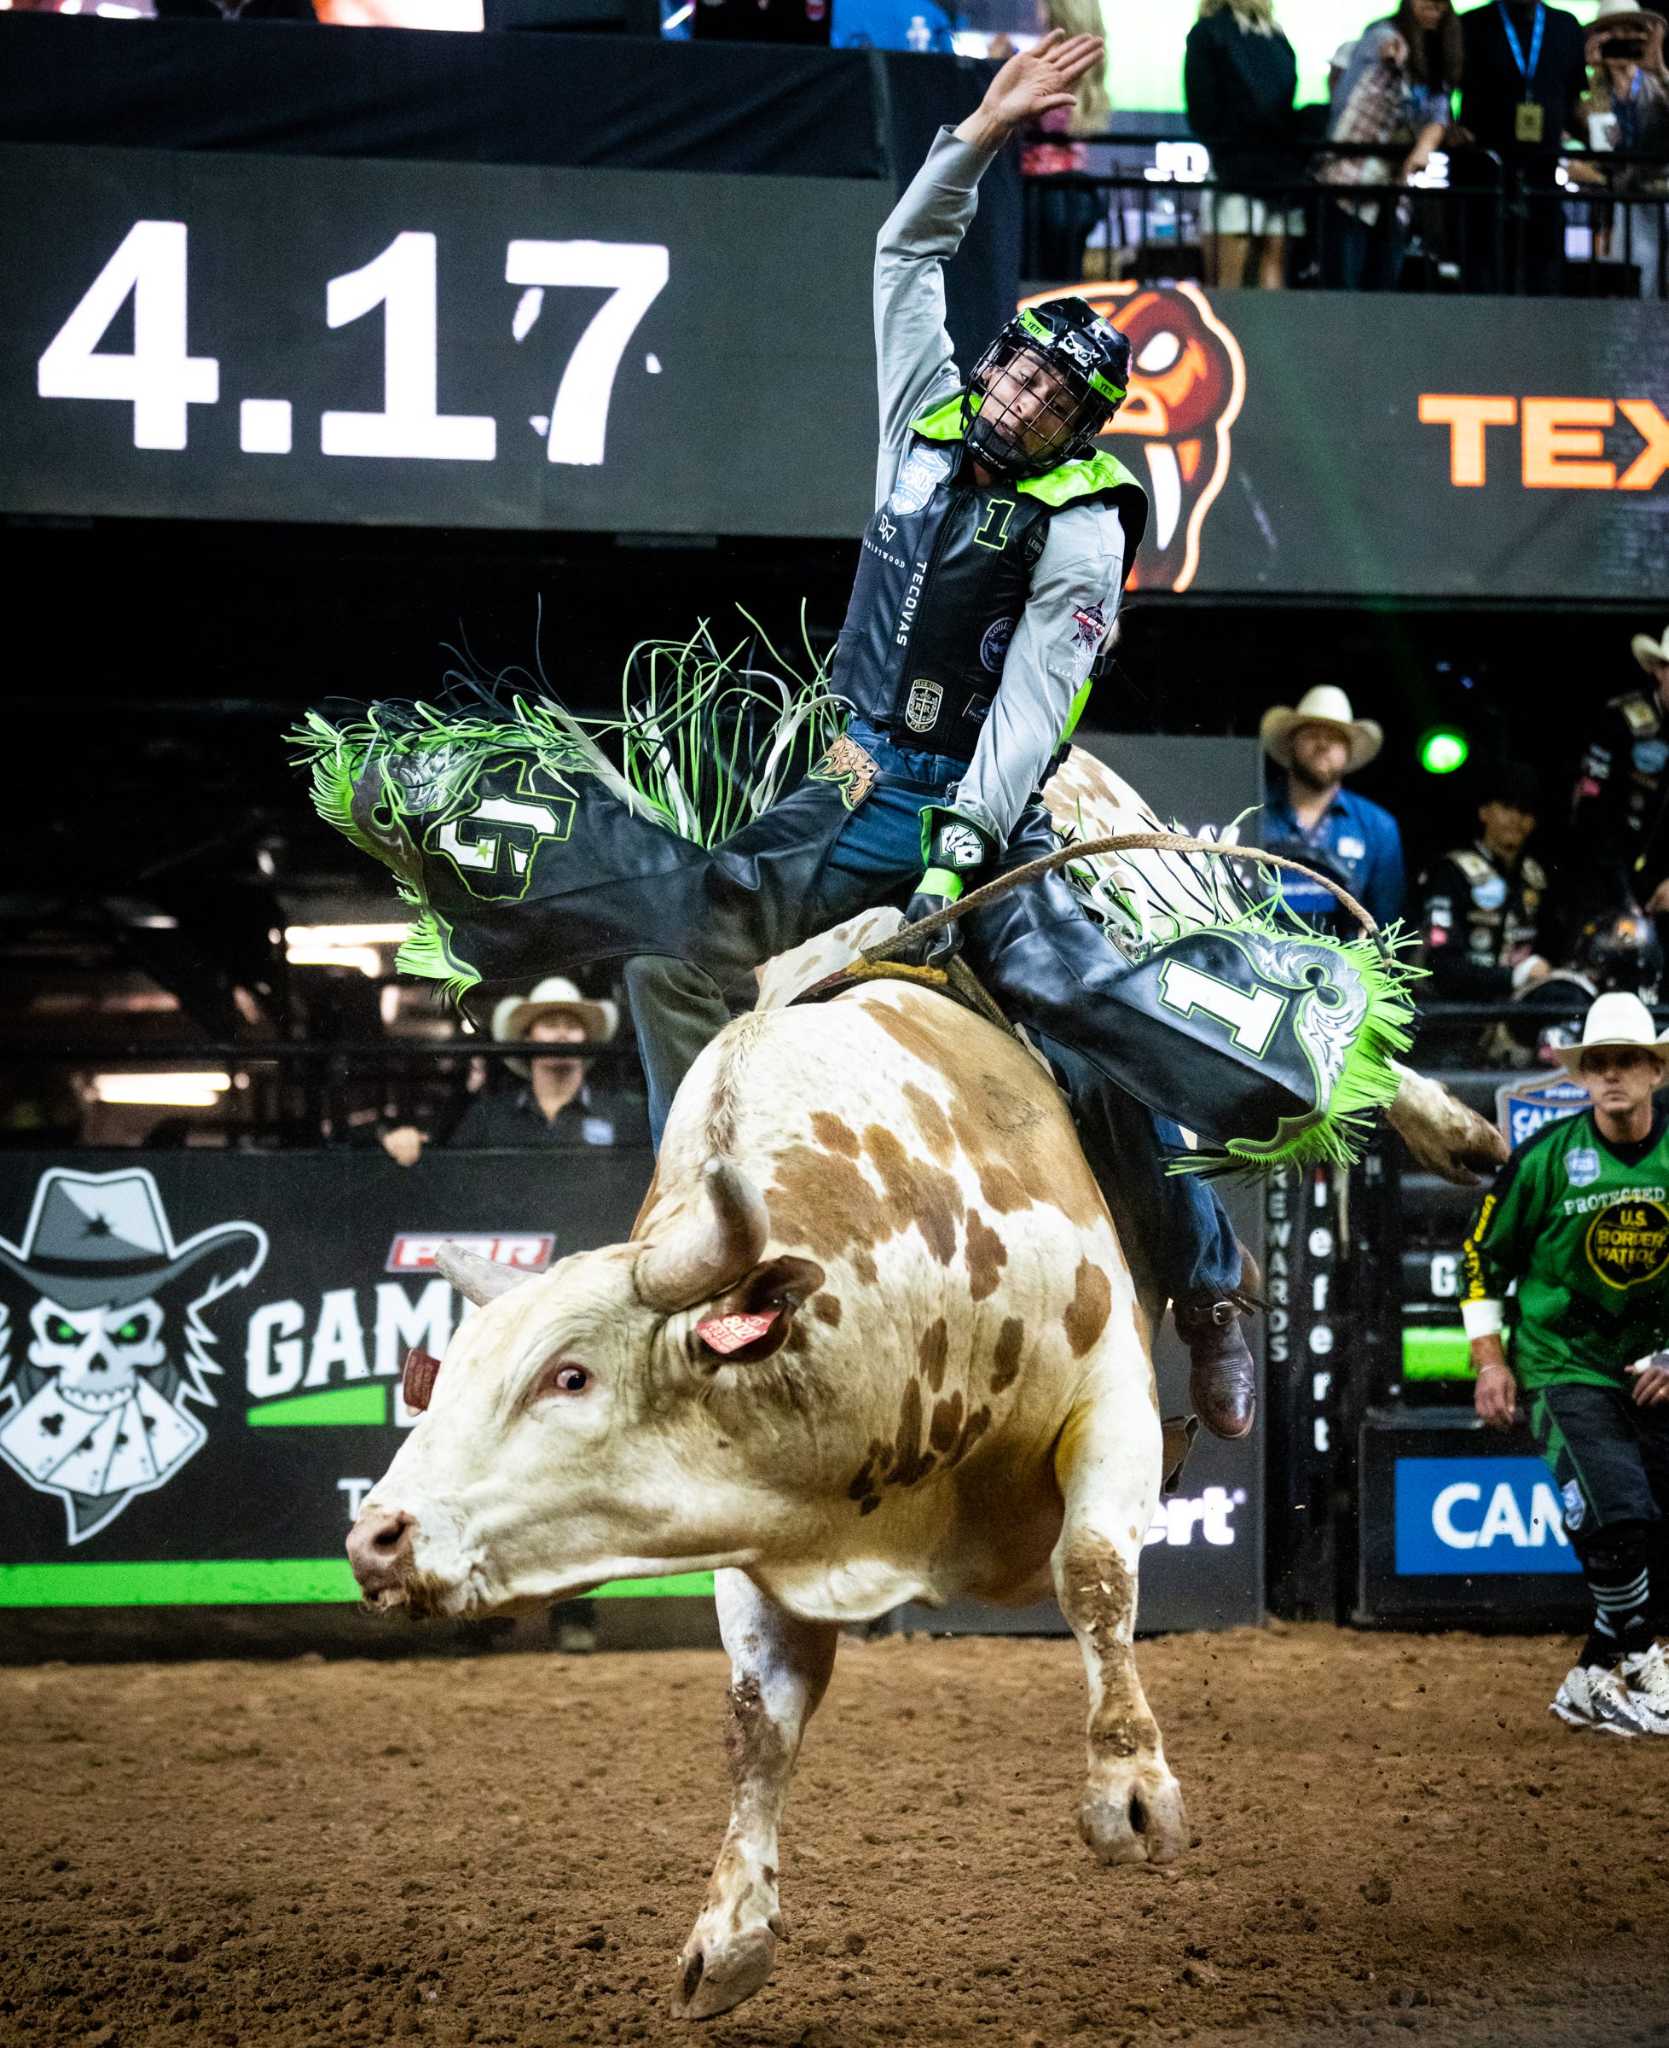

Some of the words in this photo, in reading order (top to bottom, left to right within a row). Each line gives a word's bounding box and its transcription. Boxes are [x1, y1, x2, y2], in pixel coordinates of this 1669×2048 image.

[37, 220, 669, 465] 4.17
[1026, 320, 1043, 336] YETI
[974, 498, 1016, 551] 1
[896, 561, 928, 646] TECOVAS
[1159, 958, 1288, 1060] 1
[1563, 1186, 1666, 1216] PROTECTED
[1597, 1229, 1665, 1249] BORDER
[245, 1278, 482, 1398] GAM
